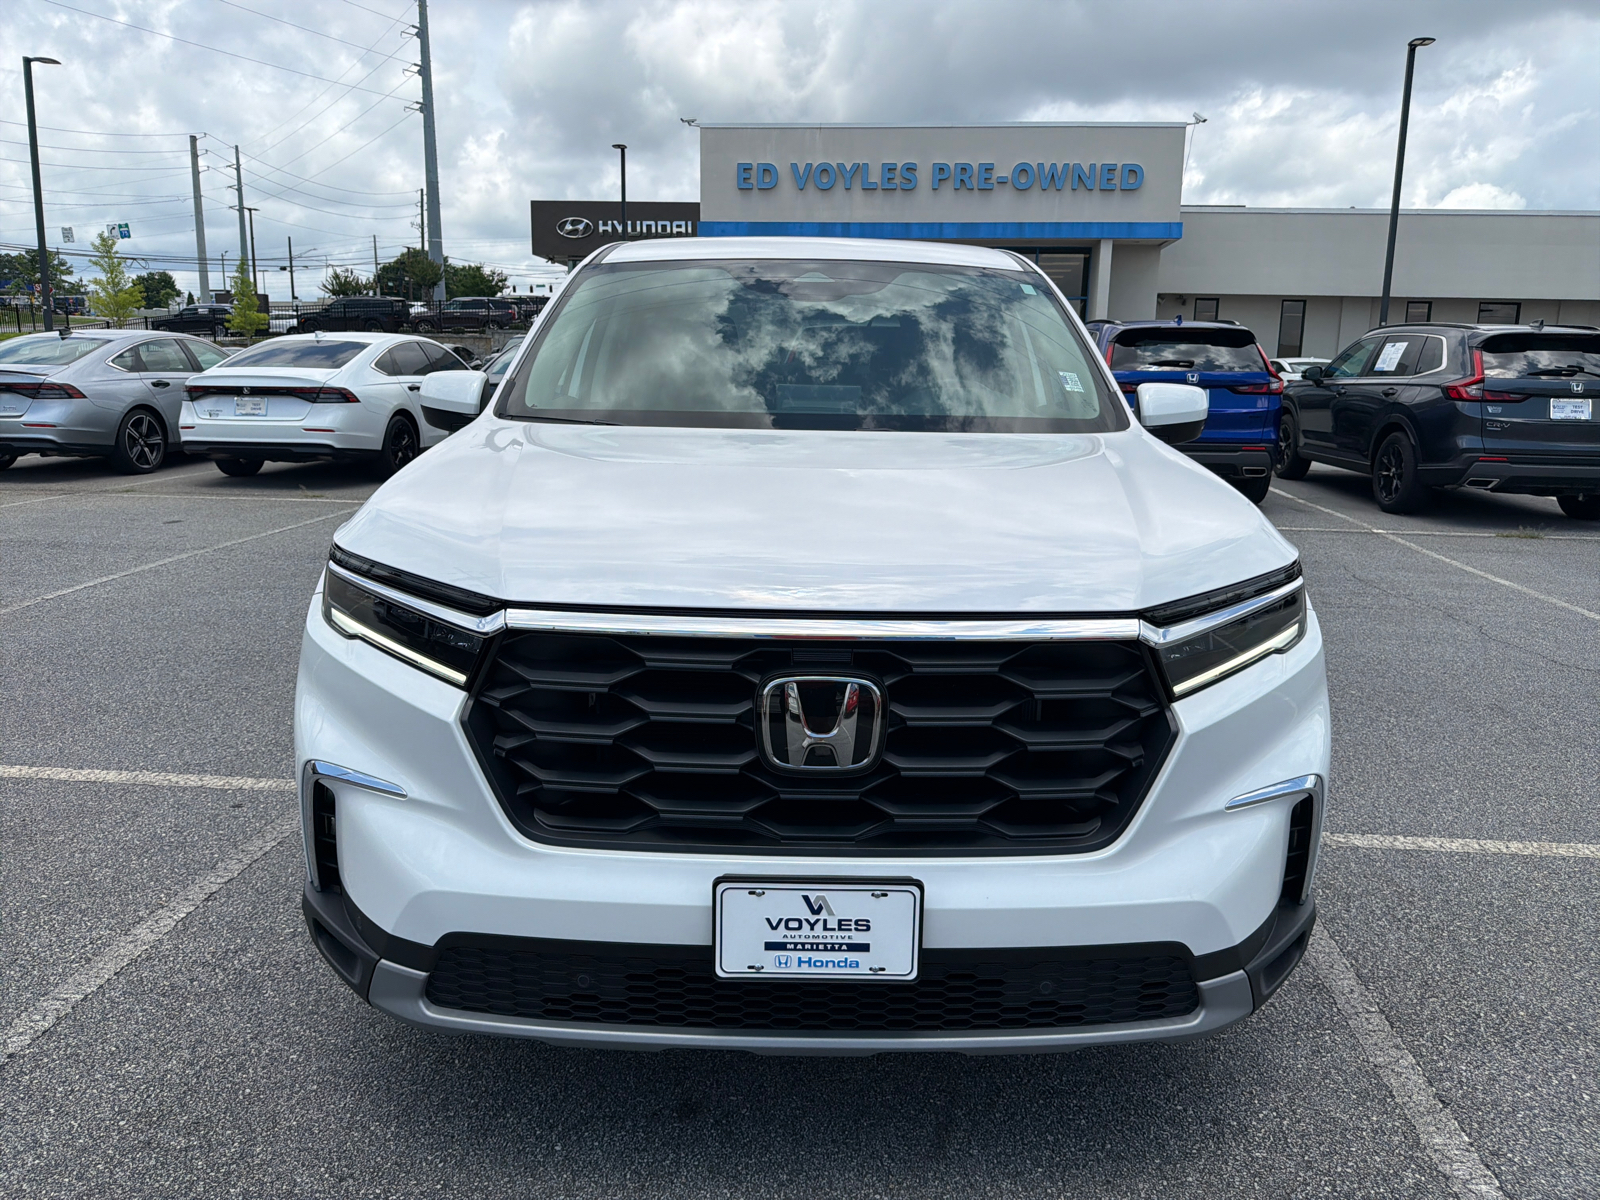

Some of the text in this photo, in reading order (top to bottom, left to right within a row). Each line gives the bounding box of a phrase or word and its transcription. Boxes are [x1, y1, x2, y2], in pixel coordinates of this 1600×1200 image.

[736, 162, 1145, 191] ED VOYLES PRE-OWNED
[598, 220, 692, 236] HYUNDAI
[765, 917, 871, 932] VOYLES
[797, 956, 860, 968] Honda
